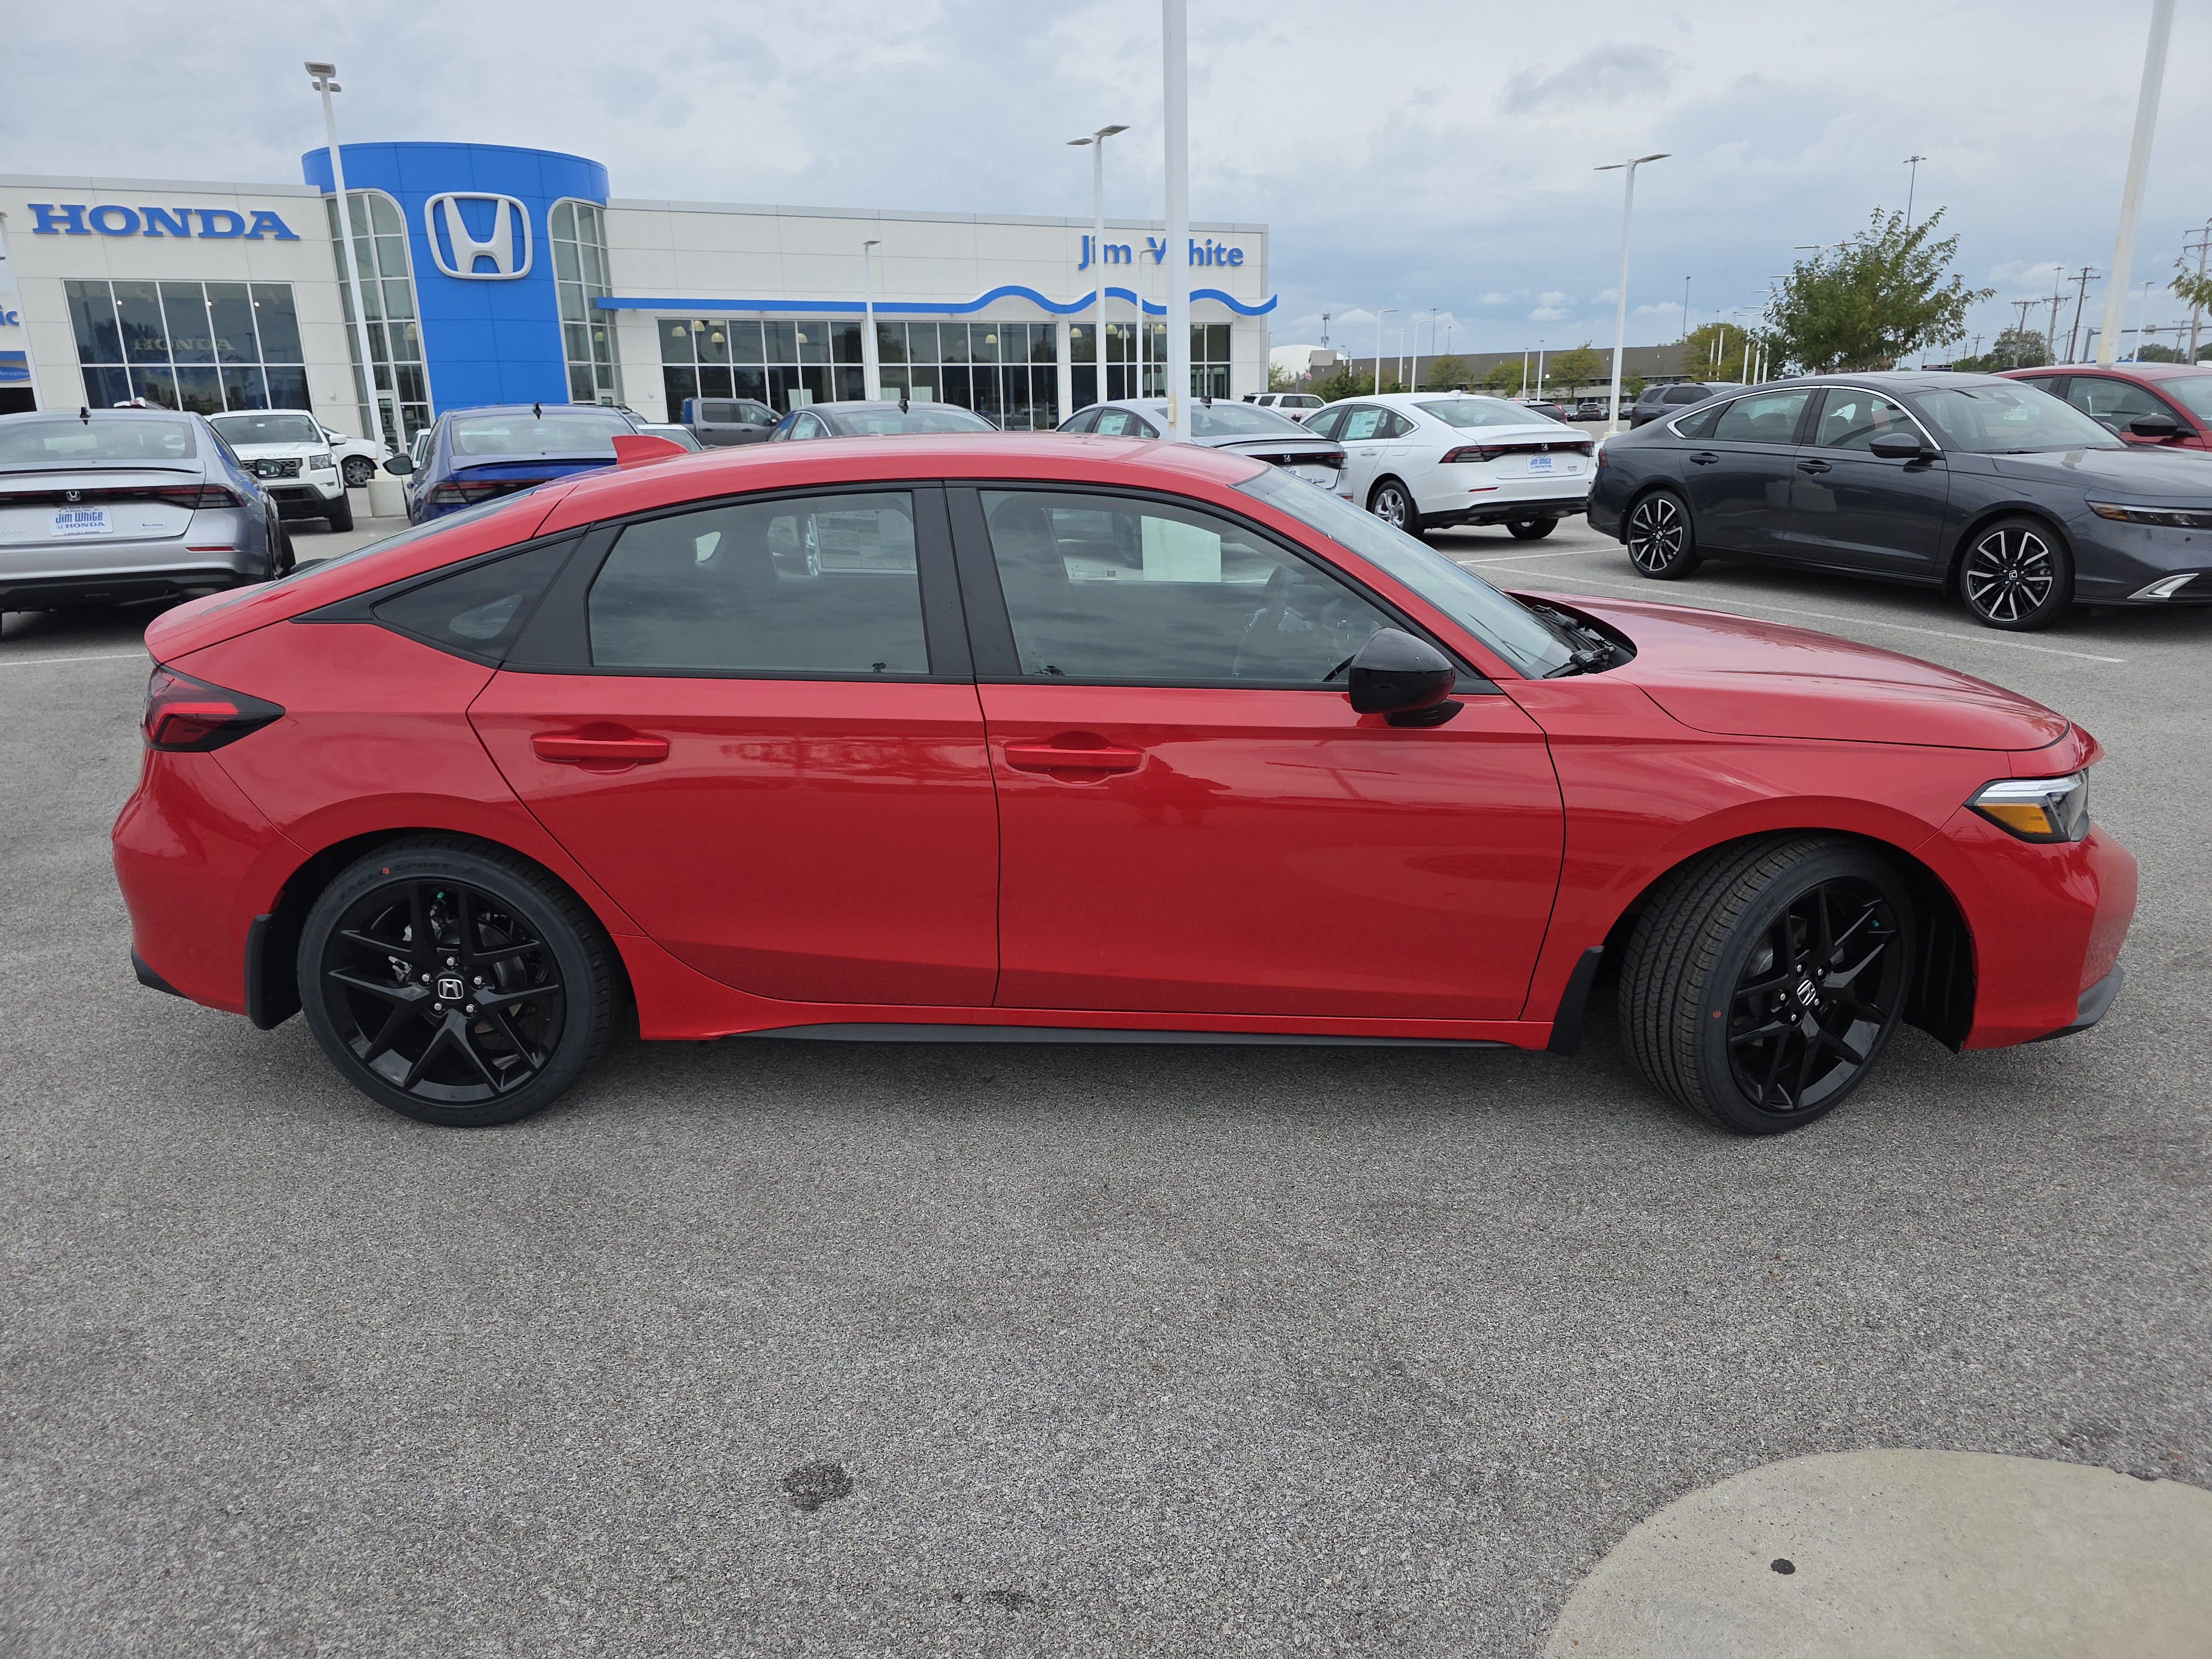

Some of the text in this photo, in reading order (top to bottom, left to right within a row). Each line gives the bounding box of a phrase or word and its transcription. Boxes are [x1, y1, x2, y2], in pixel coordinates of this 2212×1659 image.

[27, 203, 300, 241] HONDA
[1078, 235, 1131, 270] Jim
[134, 337, 237, 351] HONDA
[75, 511, 103, 523] White
